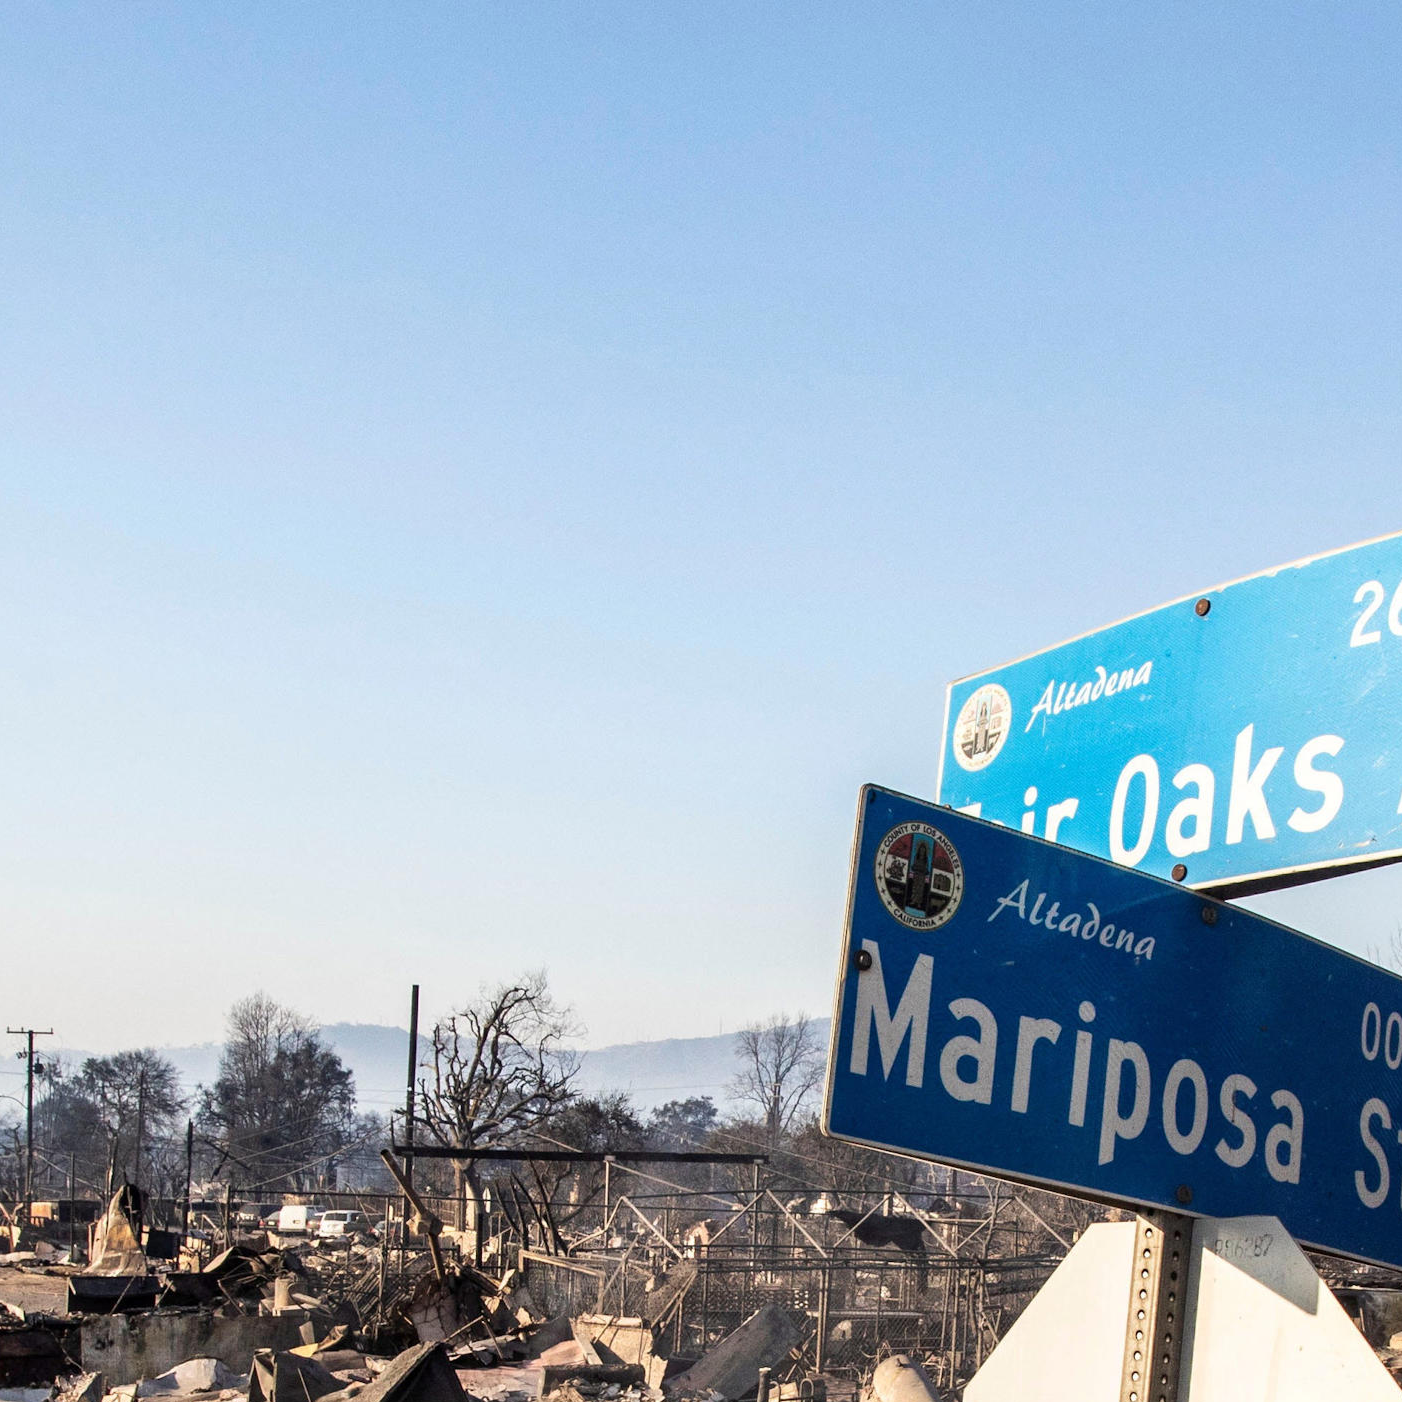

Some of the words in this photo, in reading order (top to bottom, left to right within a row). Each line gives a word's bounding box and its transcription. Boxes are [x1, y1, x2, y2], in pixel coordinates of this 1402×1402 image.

[1024, 660, 1154, 733] Altadena
[955, 786, 1080, 843] ir
[1109, 723, 1346, 868] Oaks
[884, 825, 909, 848] COUNTY
[910, 824, 920, 832] OF
[923, 825, 936, 837] LOS
[937, 835, 960, 869] ANGELES
[893, 908, 936, 928] CALIFORNIA
[987, 878, 1156, 960] Altadena
[849, 938, 1305, 1185] Mariposa
